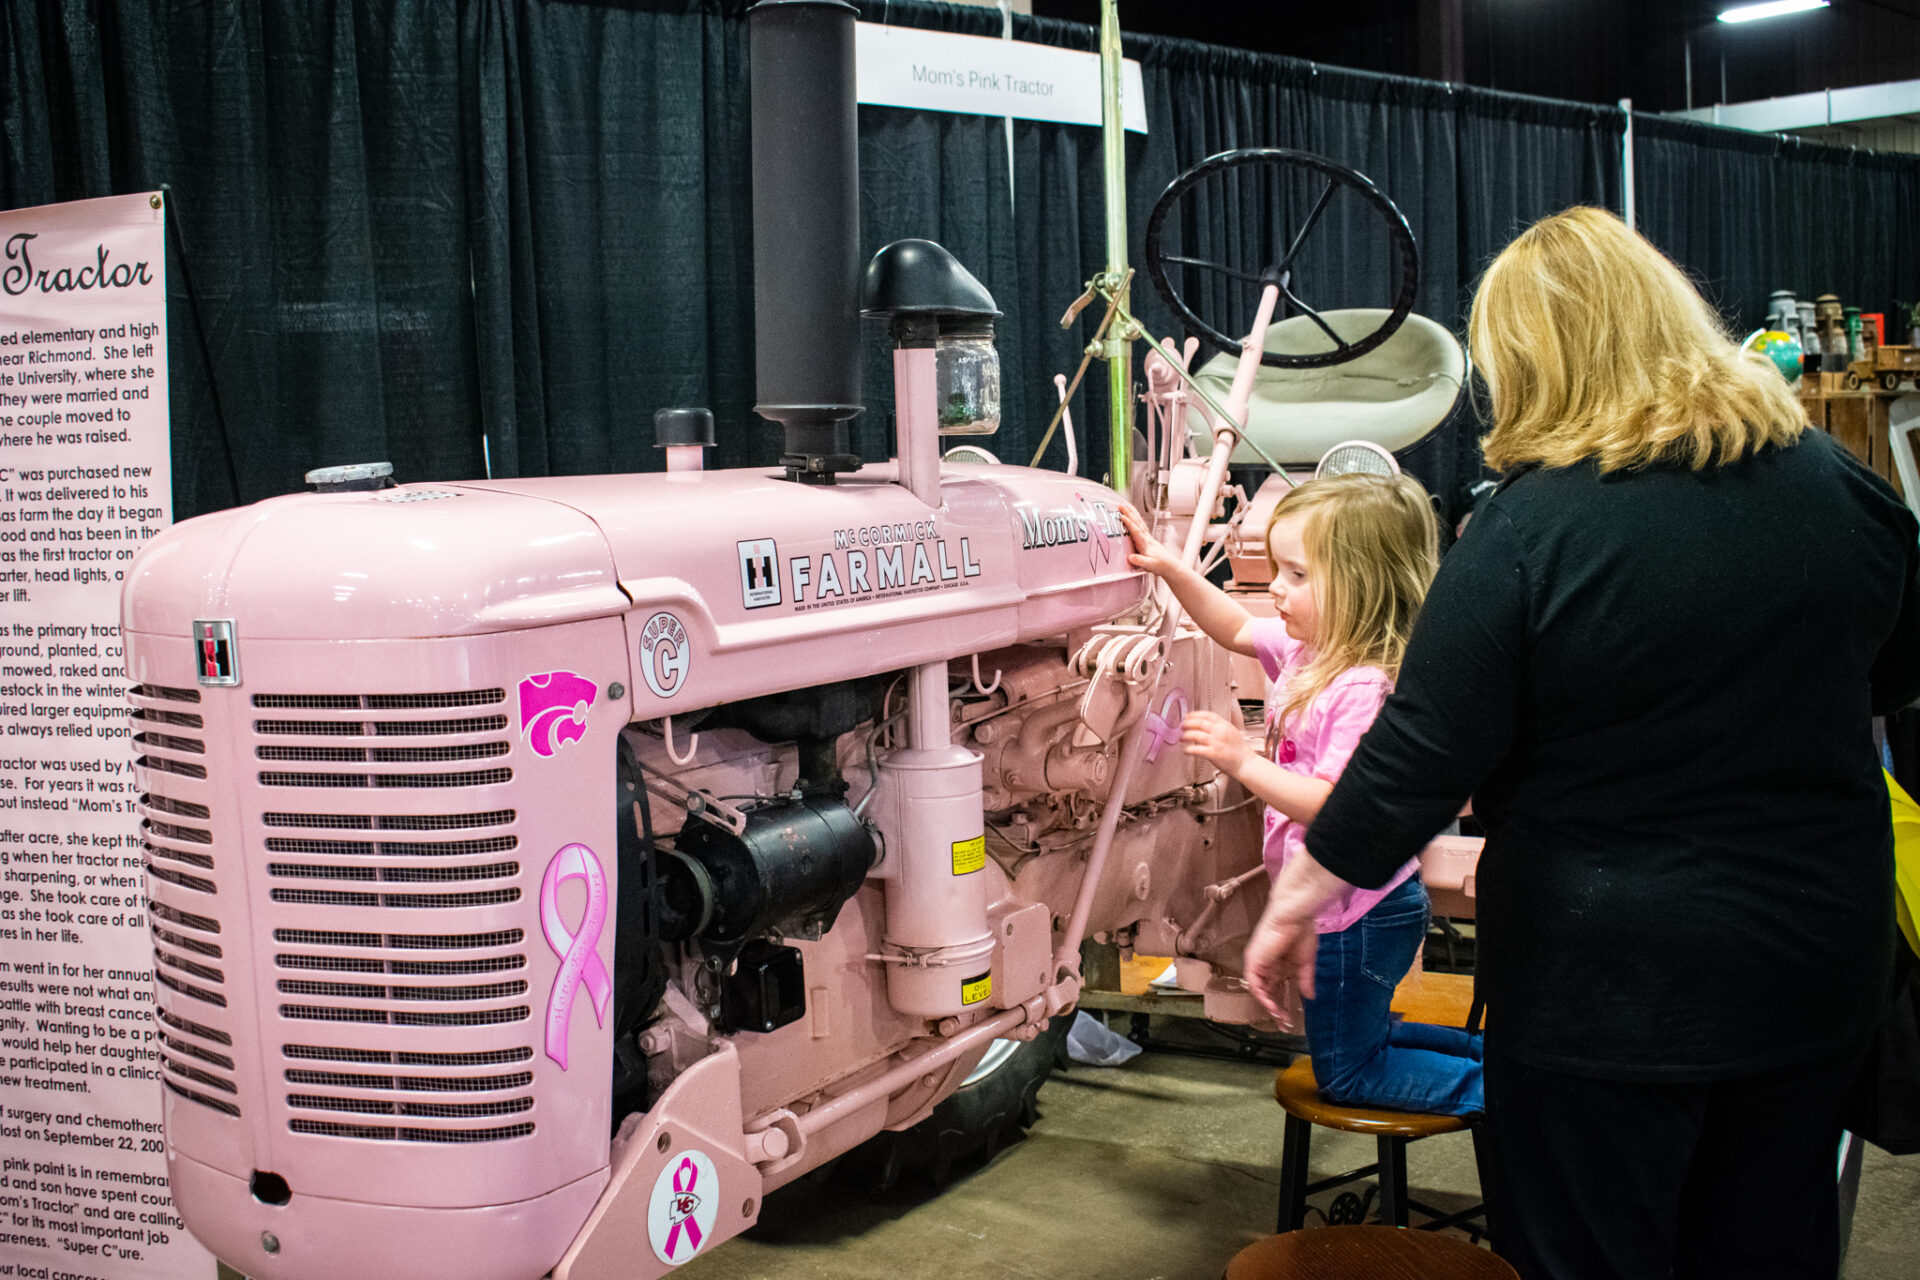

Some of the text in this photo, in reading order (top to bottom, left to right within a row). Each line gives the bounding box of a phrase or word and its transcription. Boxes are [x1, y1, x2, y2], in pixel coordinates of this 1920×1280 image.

[912, 64, 1054, 96] Mom's Pink Tractor
[3, 233, 153, 295] Tractor
[22, 323, 158, 344] elementary and high
[29, 344, 153, 364] Richmond. She left
[19, 365, 154, 385] University, where she
[31, 386, 148, 404] were married and
[18, 408, 130, 427] couple moved to
[37, 429, 131, 444] he was raised.
[19, 465, 151, 483] was purchased new
[6, 485, 148, 501] It was delivered to his
[20, 506, 162, 522] farm the day it began
[31, 526, 137, 541] and has been in
[1016, 505, 1089, 550] Mom's
[19, 548, 133, 561] the first tractor on
[35, 568, 110, 584] head lights,
[790, 537, 981, 602] FARMALL
[14, 589, 30, 601] lift.
[13, 624, 87, 639] the primary
[643, 616, 685, 652] SUPER
[48, 644, 101, 659] planted,
[3, 664, 97, 677] mowed, raked
[653, 638, 679, 691] C
[47, 683, 82, 696] in the
[31, 703, 69, 719] larger
[8, 723, 92, 738] always relied
[41, 759, 122, 775] was used by
[25, 777, 124, 793] For years it was
[21, 796, 68, 810] instead
[29, 832, 122, 850] acre, she kept
[13, 850, 118, 866] when her tractor
[5, 869, 136, 887] sharpening, or when
[31, 889, 137, 907] She took care of
[2, 908, 144, 927] as she took care of all
[21, 927, 82, 943] in her life.
[14, 962, 153, 981] went in for her annual
[38, 984, 129, 1000] were not what
[964, 989, 991, 1002] LEVEL
[974, 983, 986, 992] OIL
[35, 1001, 104, 1017] with breast
[37, 1020, 139, 1039] Wanting to be a
[2, 1038, 96, 1055] would help her
[10, 1057, 115, 1076] participated in a
[25, 1076, 90, 1093] treatment.
[8, 1109, 81, 1125] surgery and
[0, 1124, 136, 1152] lost on September 22,
[4, 1158, 92, 1179] pink paint is in
[13, 1179, 137, 1202] and son have spent
[84, 1207, 109, 1218] and
[114, 1210, 135, 1221] are
[140, 1212, 185, 1230] calling
[12, 1213, 169, 1245] for its most important job
[17, 1264, 48, 1279] local
